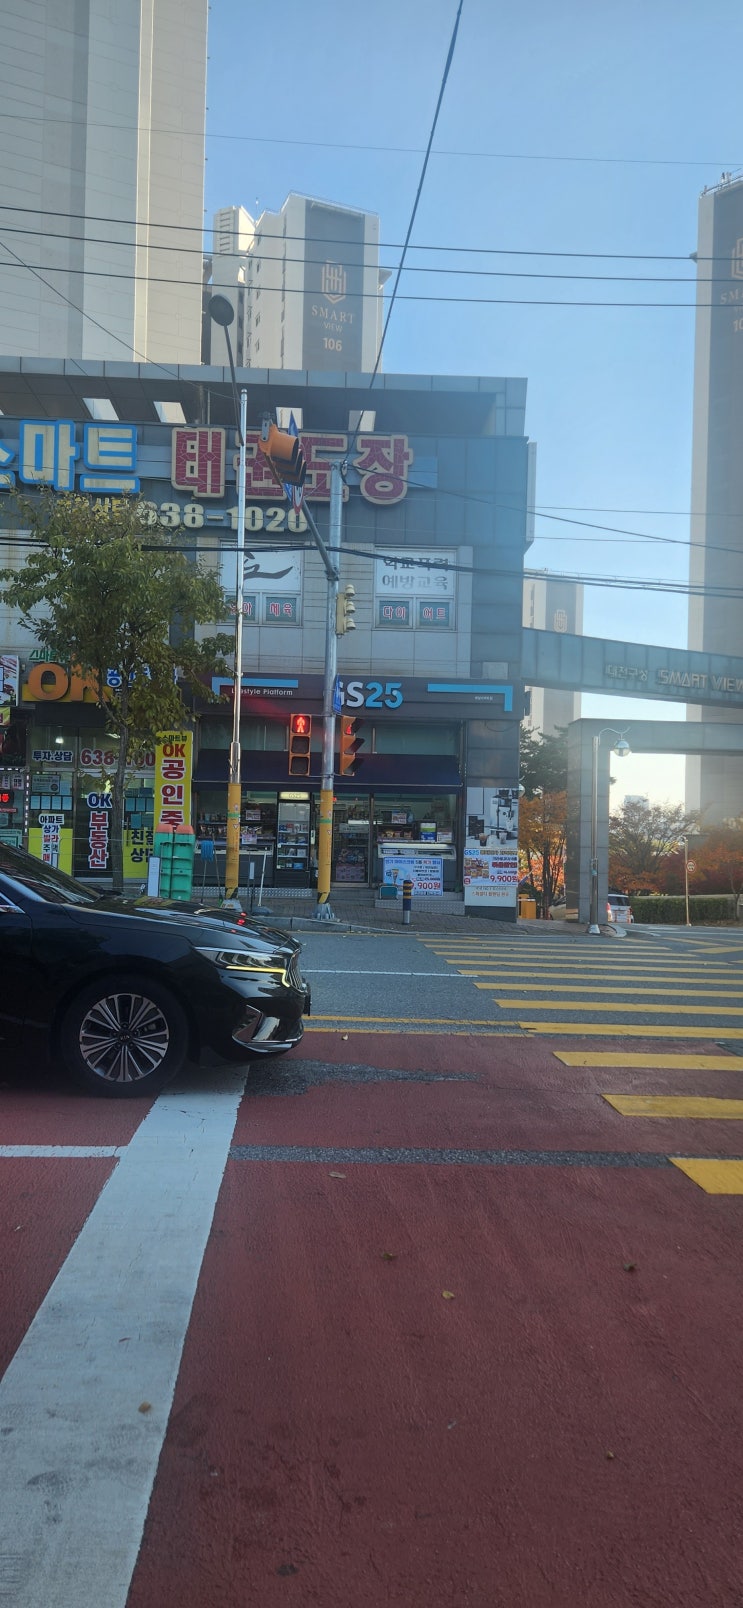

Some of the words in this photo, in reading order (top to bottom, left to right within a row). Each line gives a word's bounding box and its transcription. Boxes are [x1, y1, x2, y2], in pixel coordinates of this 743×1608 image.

[311, 305, 355, 324] SMART
[323, 321, 343, 333] VIEW
[323, 337, 342, 351] 106
[382, 574, 449, 591] 예방교육
[28, 657, 111, 701] OK
[659, 669, 707, 689] SMART
[340, 681, 403, 708] S25
[163, 743, 186, 757] OK
[87, 792, 112, 808] OK
[39, 814, 64, 824] 아파트
[89, 811, 109, 868] 부동산
